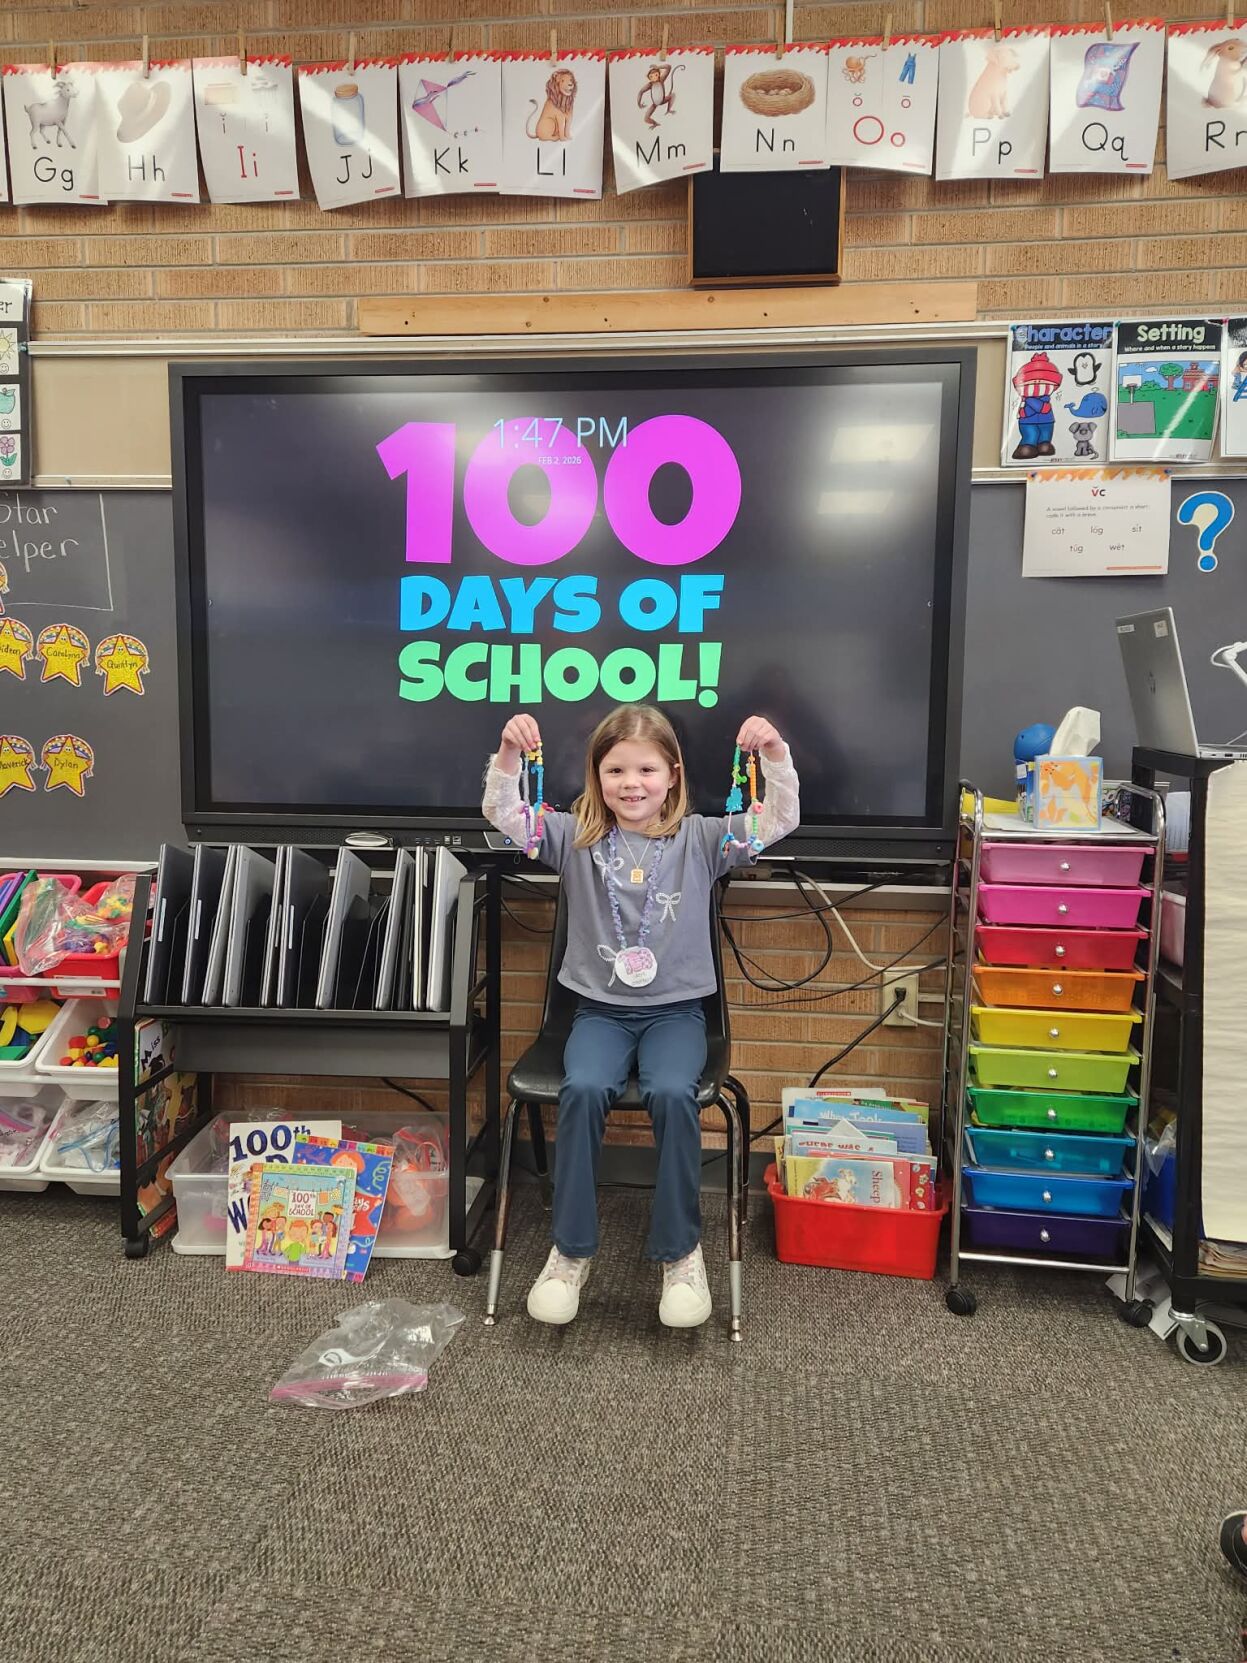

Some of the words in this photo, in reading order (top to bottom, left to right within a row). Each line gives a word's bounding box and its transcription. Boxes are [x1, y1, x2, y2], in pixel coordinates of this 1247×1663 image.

[636, 136, 686, 169] Mm
[756, 128, 795, 153] Nn
[972, 127, 1013, 165] Pp
[1082, 122, 1129, 161] Qq
[34, 157, 74, 191] Gg
[128, 155, 165, 182] Hh
[237, 145, 258, 178] Ii
[434, 147, 469, 175] Kk
[537, 148, 566, 176] Ll
[1016, 324, 1112, 343] Character
[1137, 323, 1206, 343] Setting
[494, 417, 563, 449] 1:47
[577, 416, 627, 448] PM
[538, 456, 552, 465] FEB
[562, 455, 582, 465] 2026
[375, 414, 742, 566] 100
[400, 574, 602, 634] DAYS
[618, 574, 725, 633] OF
[398, 640, 723, 709] SCHOOL!
[54, 757, 79, 770] Dylan
[870, 1169, 883, 1204] Sheep
[289, 1208, 314, 1217] SCHOOL
